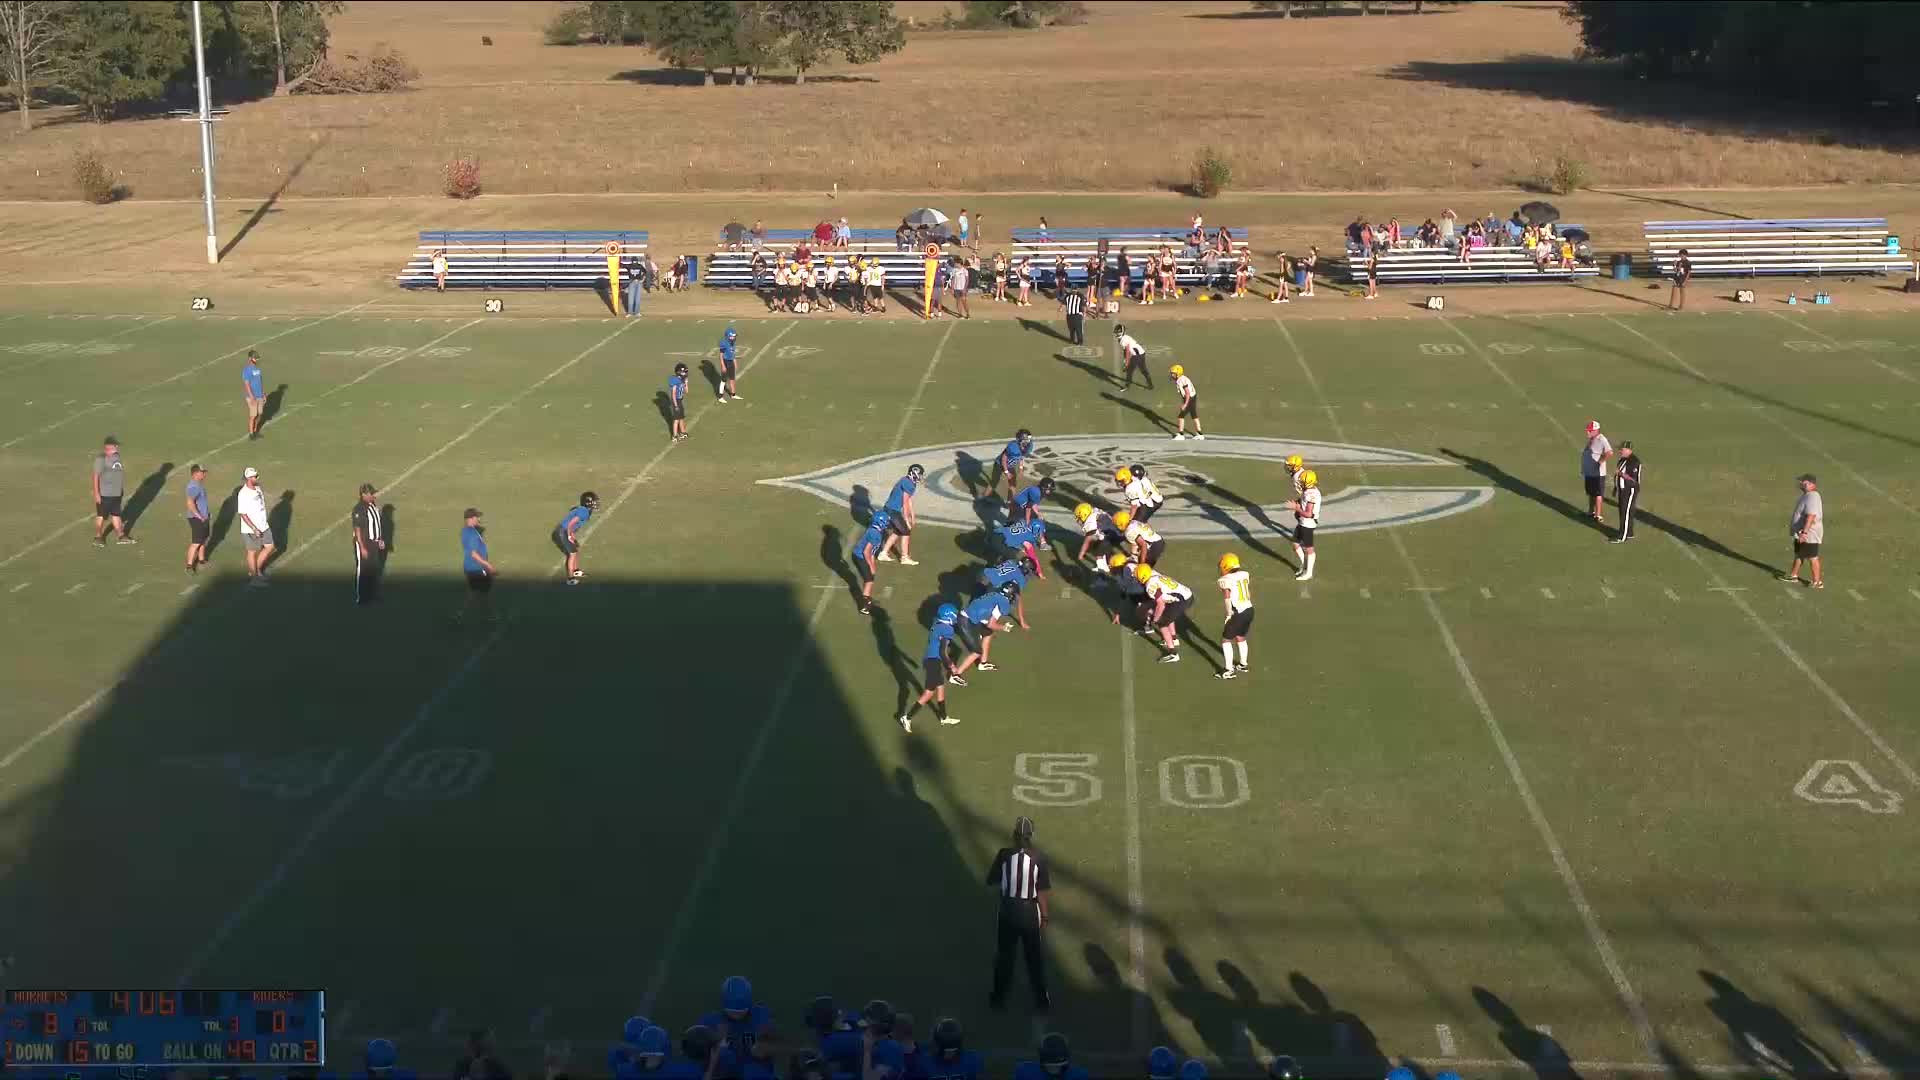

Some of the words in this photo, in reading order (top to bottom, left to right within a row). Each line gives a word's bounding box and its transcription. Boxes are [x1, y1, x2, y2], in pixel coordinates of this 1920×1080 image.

[1738, 290, 1754, 302] 30
[192, 298, 209, 310] 20
[486, 299, 502, 312] 30
[793, 302, 809, 313] 40
[1428, 297, 1444, 309] 40
[1793, 759, 1905, 814] 4
